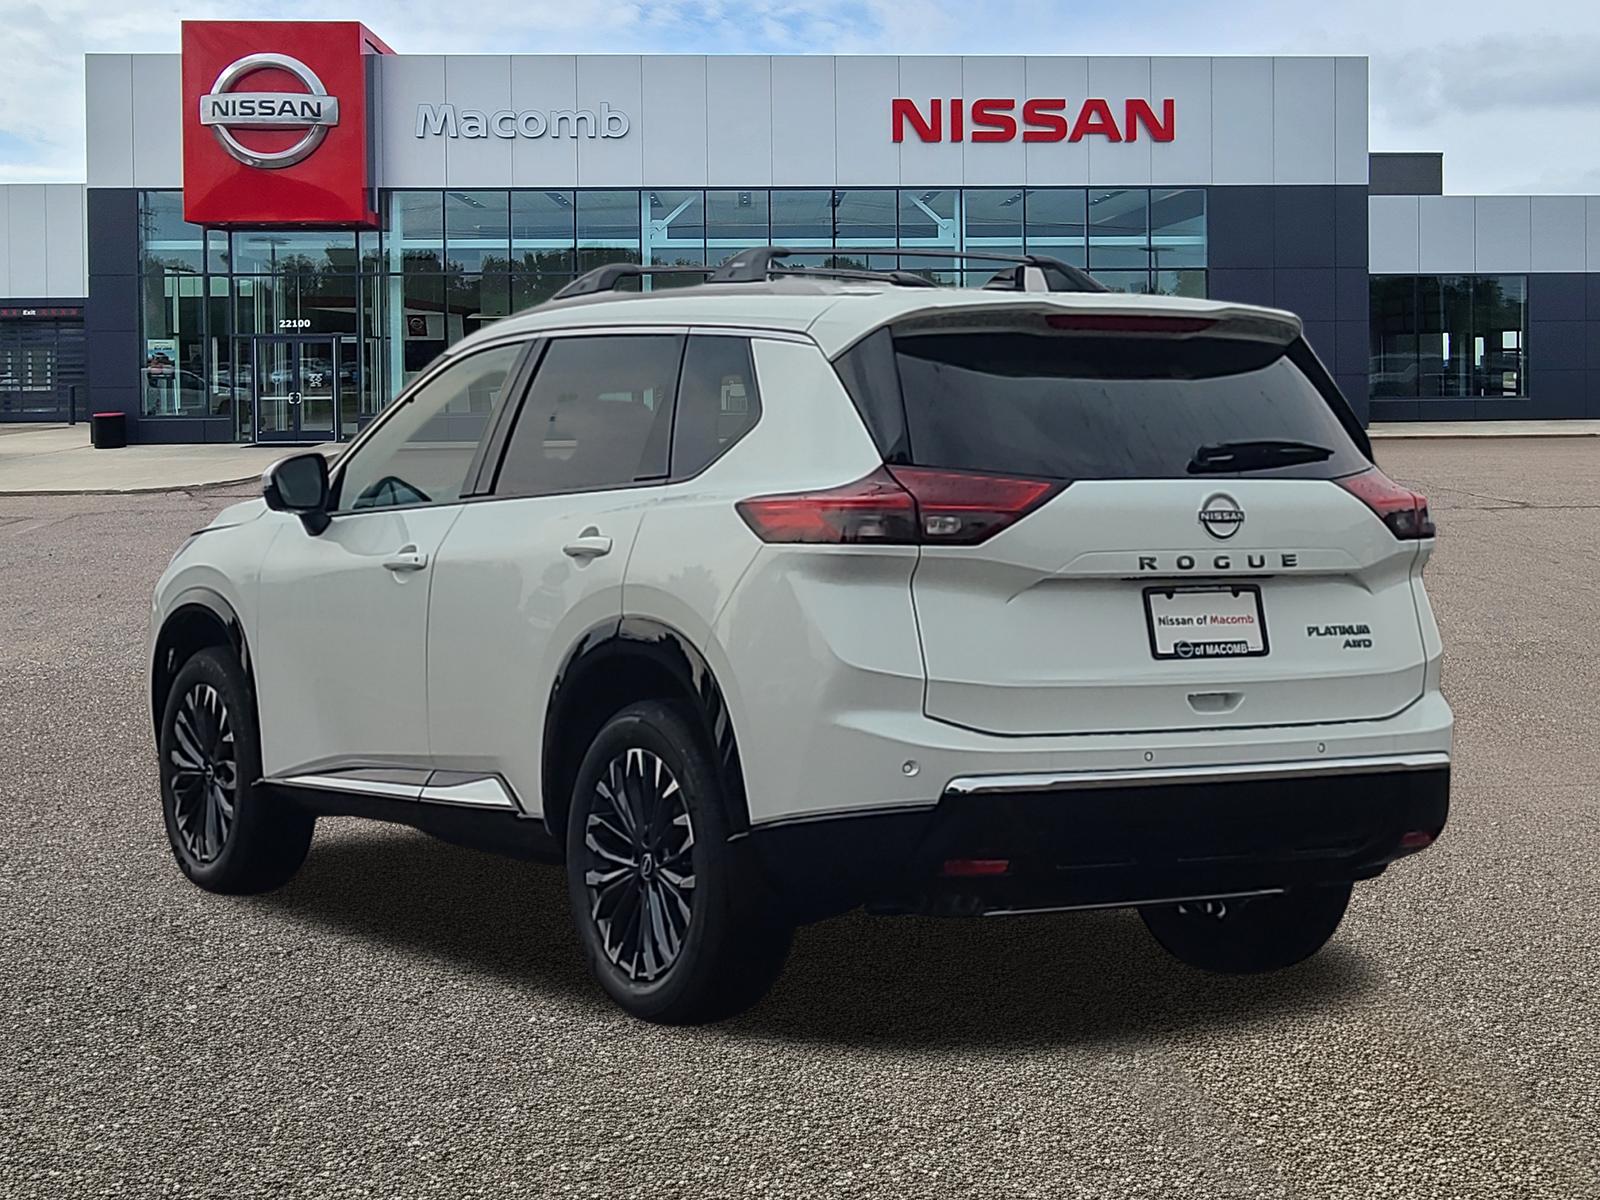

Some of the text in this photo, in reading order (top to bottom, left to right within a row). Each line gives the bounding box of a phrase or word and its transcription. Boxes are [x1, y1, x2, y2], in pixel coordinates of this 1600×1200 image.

[211, 101, 322, 118] NISSAN
[415, 102, 630, 138] Macomb
[892, 98, 1175, 143] NISSAN
[279, 319, 311, 328] 22100
[1200, 512, 1244, 520] NISSAN
[1138, 554, 1298, 571] ROGUE
[1158, 614, 1255, 626] Nissan of Macomb
[1306, 624, 1371, 637] PLATINUM
[1194, 643, 1248, 655] of MACOMB
[1342, 638, 1373, 649] AWD
